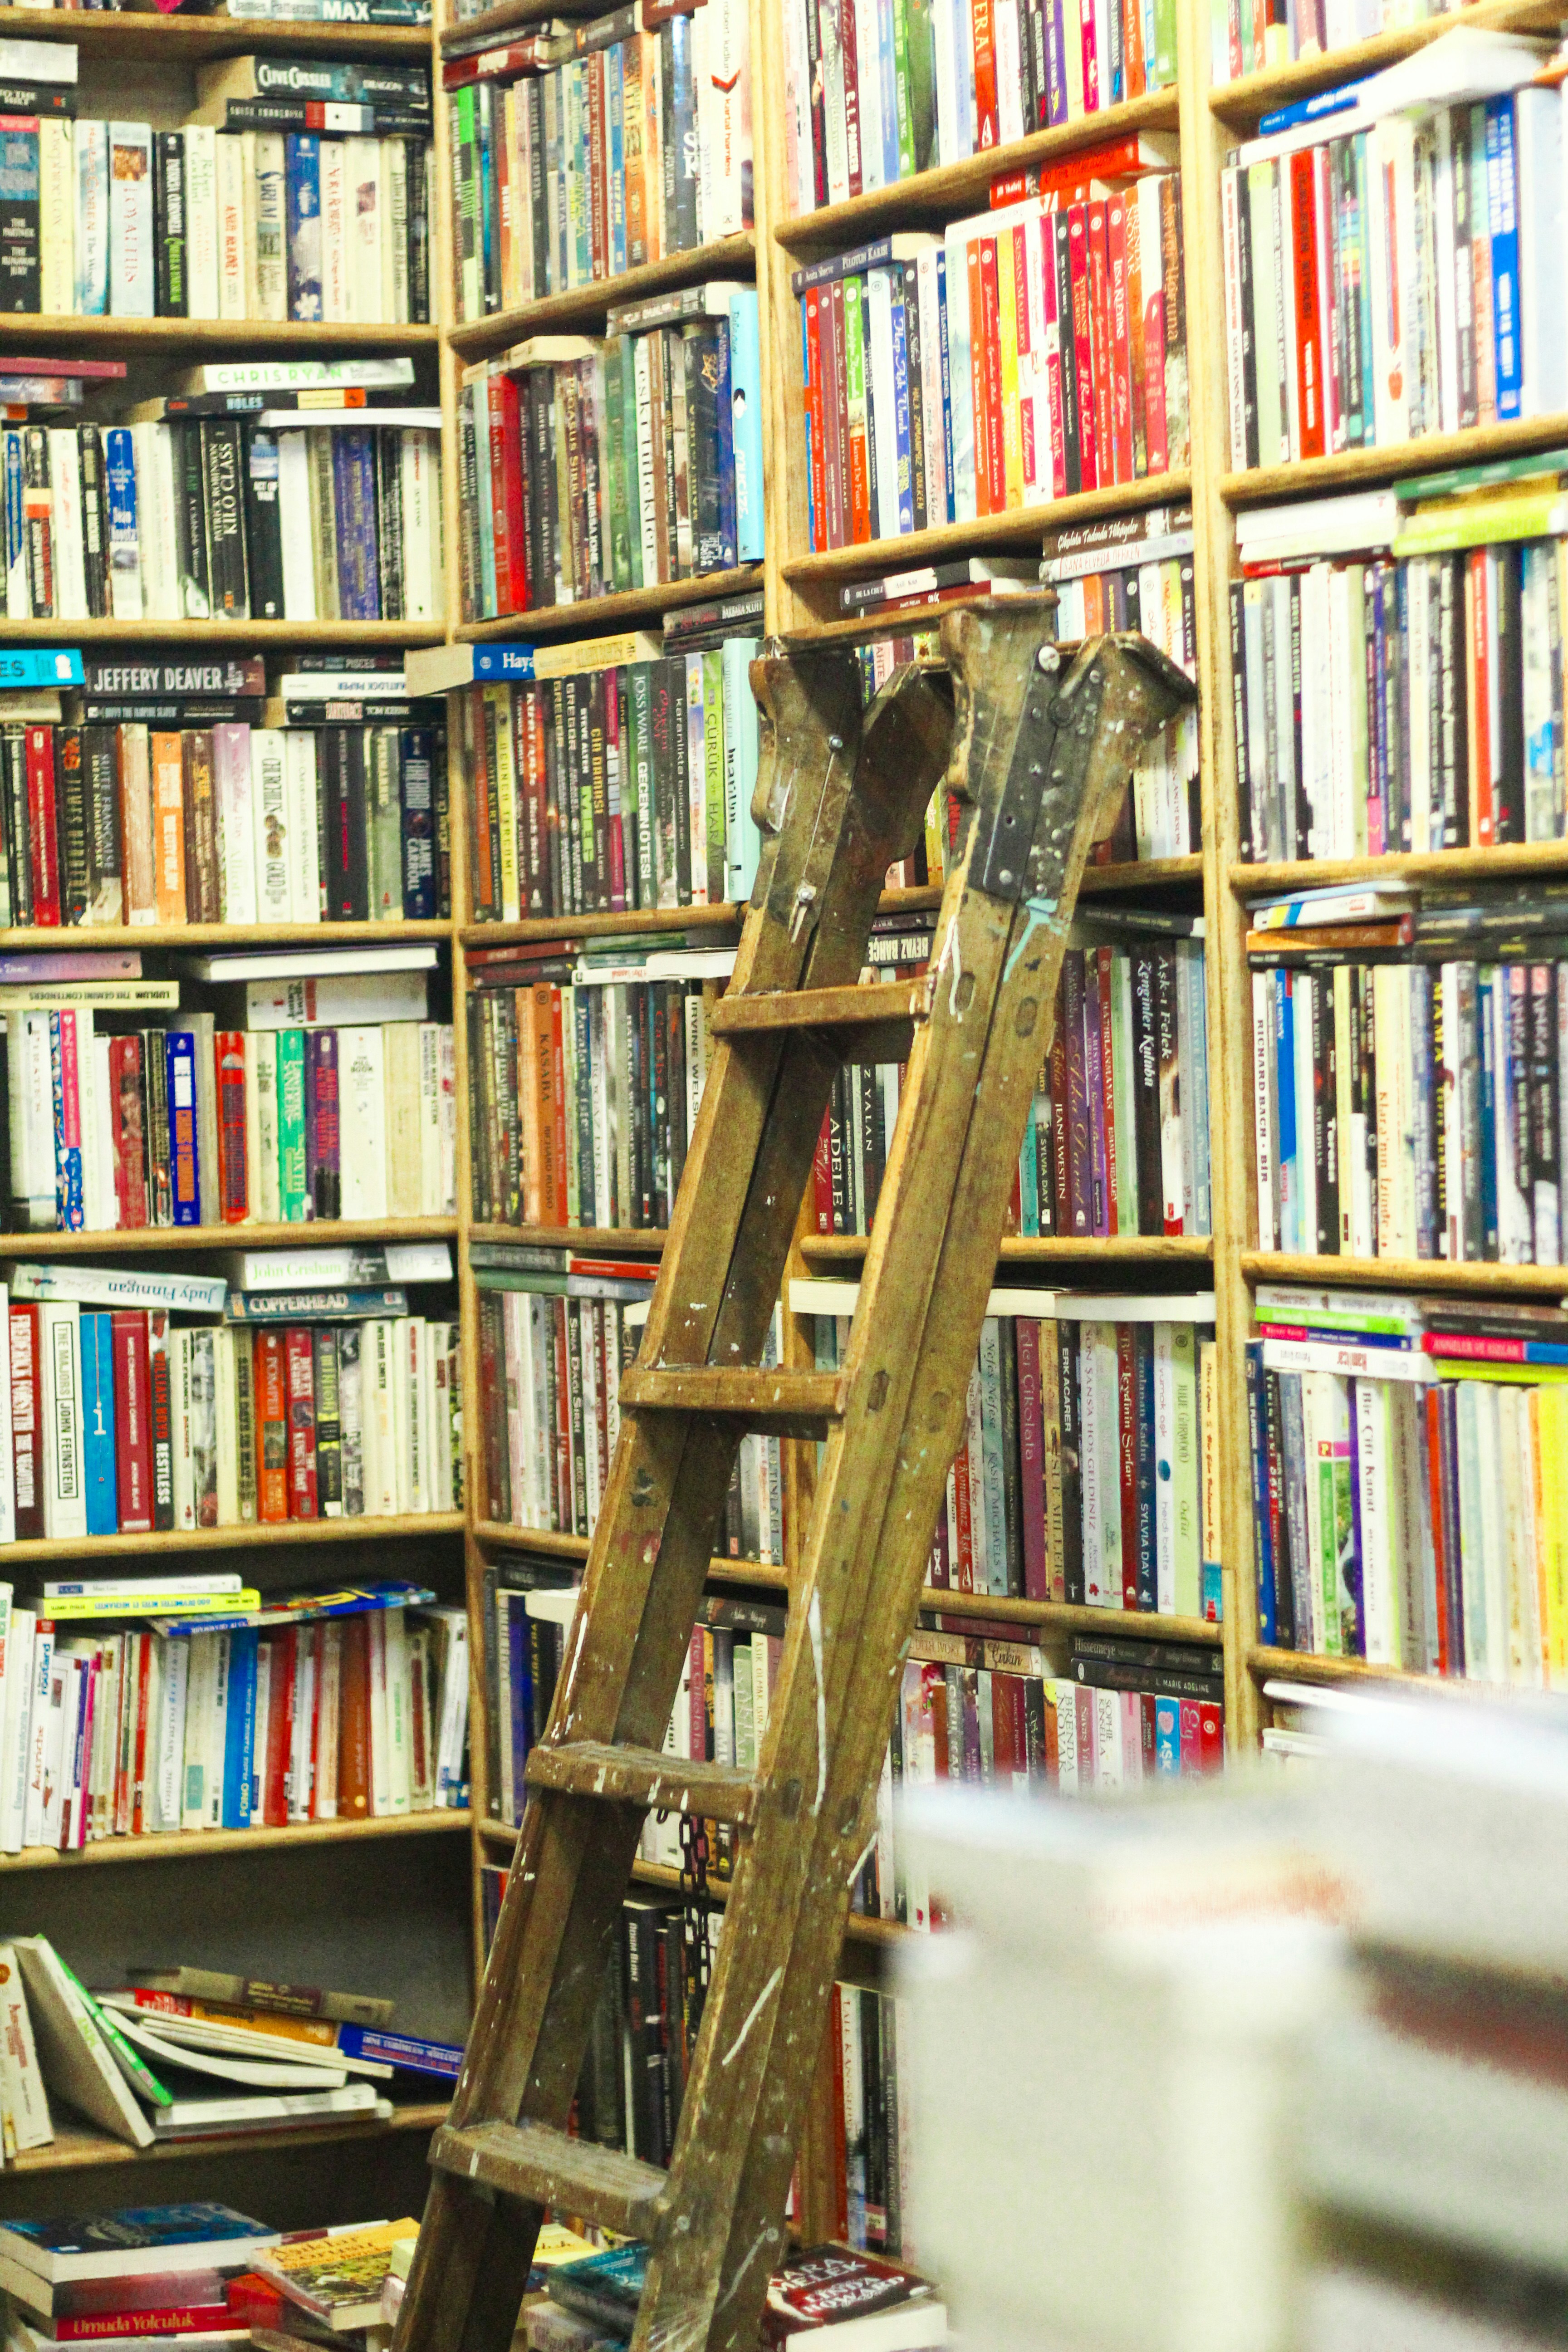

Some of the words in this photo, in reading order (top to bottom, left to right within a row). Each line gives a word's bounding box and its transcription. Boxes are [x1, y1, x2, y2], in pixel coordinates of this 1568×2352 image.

[323, 1, 370, 20] MAX
[259, 64, 288, 87] CLIVE
[288, 66, 332, 88] CUSSLER
[255, 169, 284, 219] SARUM
[1016, 284, 1025, 349] MALLERY
[219, 370, 282, 384] CHRIS
[289, 368, 343, 383] RYAN
[566, 377, 578, 451] PEGASUS
[218, 442, 234, 493] CLASS
[221, 501, 238, 534] KILO
[95, 664, 159, 691] JEFFERY
[165, 664, 223, 690] DEAVER
[633, 674, 647, 709] JOSS
[553, 680, 565, 749] GREGOR
[566, 682, 575, 751] GREGOR
[636, 710, 648, 753] WARE
[100, 753, 114, 786] SUITE
[407, 837, 421, 891] CARROLL
[418, 838, 431, 876] JAMES
[1136, 960, 1153, 1029] Zenginler
[691, 1001, 699, 1056] IRVINE
[1160, 1011, 1173, 1059] Felek
[1433, 981, 1444, 1061] MAMA
[539, 1034, 552, 1103] KASABA
[1102, 1001, 1113, 1110] HATIRLANMAYAN
[1257, 1019, 1267, 1093] RICHARD
[864, 1088, 872, 1151] YALAN
[1054, 1103, 1064, 1144] JEANE
[1258, 1096, 1267, 1138] BACH
[830, 1117, 843, 1206] ADELE
[1039, 1138, 1048, 1176] SYLVIA
[1107, 1126, 1115, 1159] EMMA
[1041, 1179, 1049, 1203] DAY
[1057, 1146, 1066, 1198] WESTIN
[108, 1281, 177, 1300] Finnigan
[181, 1287, 216, 1305] Judy
[250, 1294, 349, 1313] COPPERHEAD
[57, 1326, 69, 1348] THE
[1021, 1331, 1034, 1366] Acı
[58, 1349, 71, 1396] MAJORS
[265, 1356, 279, 1416] POMPEII
[378, 1362, 387, 1389] SMITH
[1177, 1383, 1189, 1408] JULIE
[60, 1402, 72, 1433] JOHN
[986, 1383, 998, 1429] Nefese
[1022, 1373, 1038, 1460] Çikolata
[1063, 1377, 1071, 1432] ACARER
[61, 1437, 74, 1495] FEINSTEIN
[156, 1443, 170, 1505] RESTLESS
[989, 1451, 1000, 1490] KASEY
[991, 1497, 1002, 1566] MICHAELS
[1141, 1502, 1150, 1548] SYLVIA
[1141, 1550, 1150, 1578] DAY
[40, 1642, 51, 1696] routard
[1162, 1679, 1181, 1689] MARIE
[1183, 1681, 1209, 1693] ADELINE
[1058, 1694, 1067, 1769] NOVAK
[1066, 1695, 1075, 1771] BRENDA
[73, 2317, 130, 2334] Umuda
[132, 2310, 196, 2331] Yolculuk
